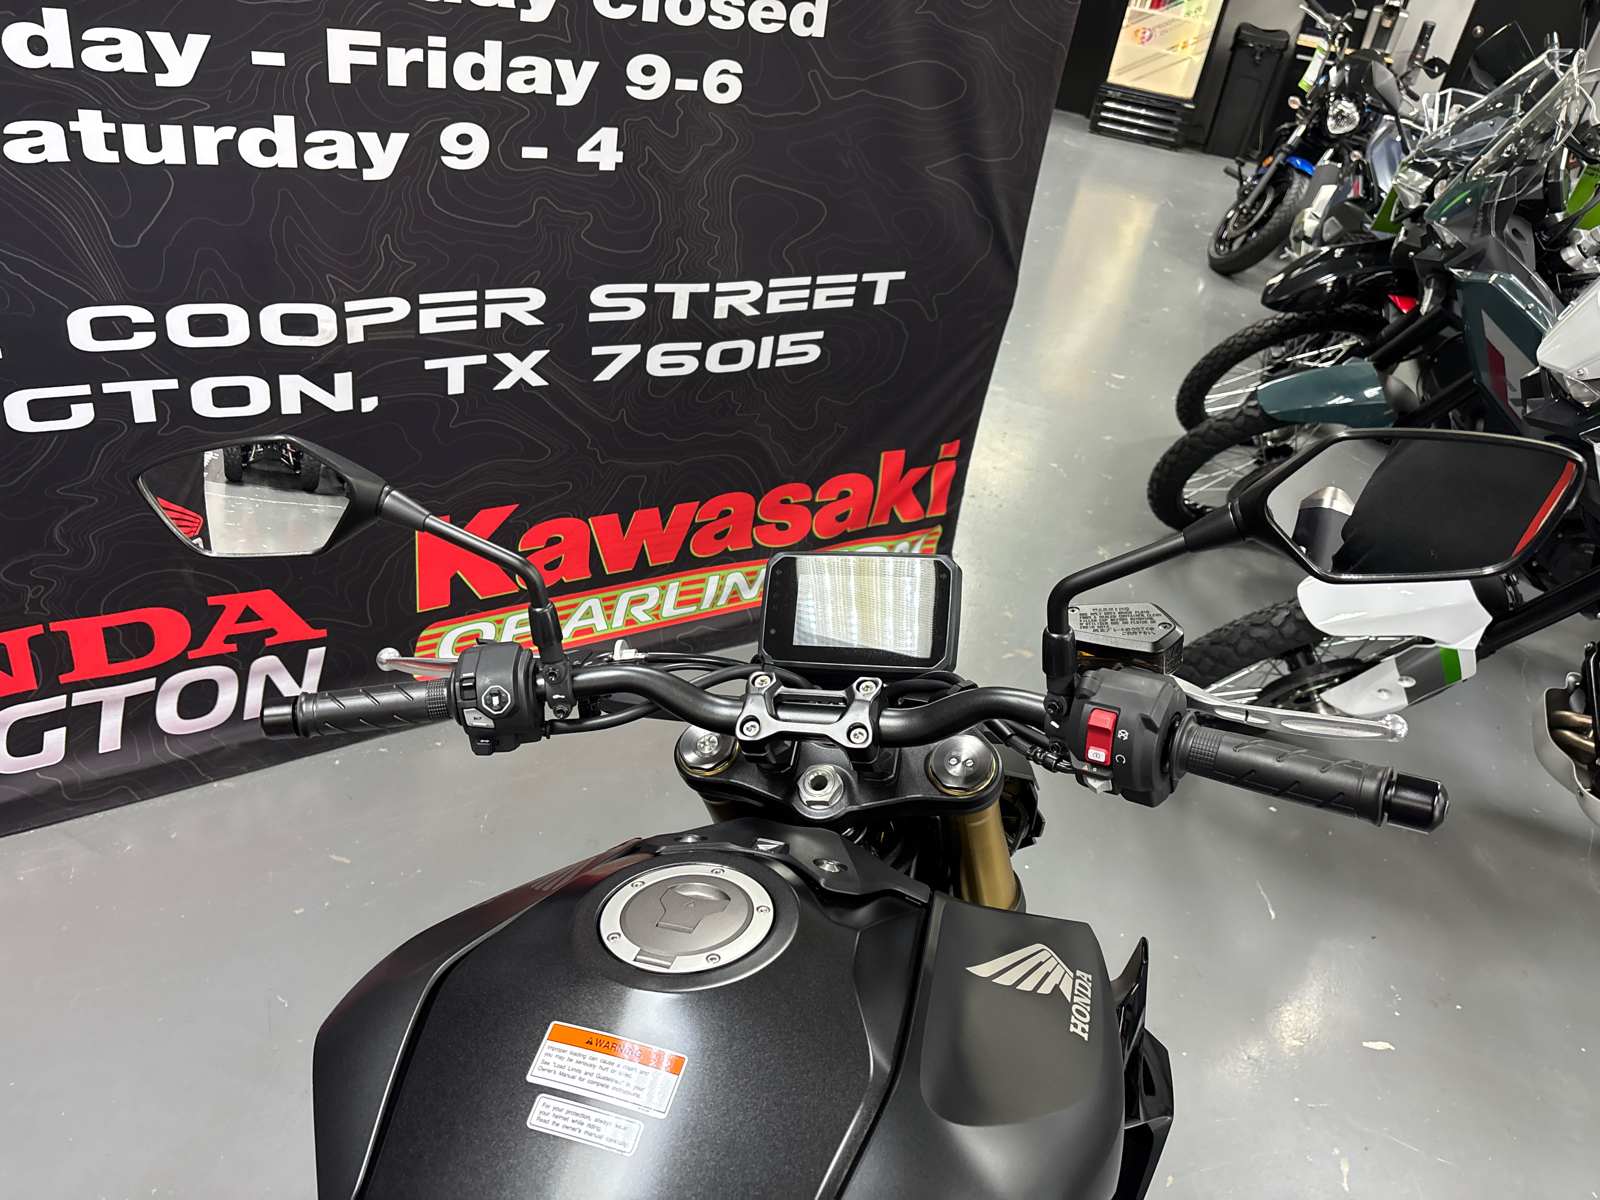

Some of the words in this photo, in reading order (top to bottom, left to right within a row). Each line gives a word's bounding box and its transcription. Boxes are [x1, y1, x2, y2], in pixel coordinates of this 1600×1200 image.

[2, 8, 211, 87] day
[251, 51, 285, 66] -
[327, 28, 599, 106] Friday
[626, 54, 743, 103] 9-6
[3, 109, 409, 180] aturday
[440, 122, 489, 169] 9
[522, 147, 548, 158] -
[577, 127, 623, 170] 4
[67, 288, 545, 352] COOPER
[589, 271, 906, 322] STREET
[4, 372, 378, 432] GTON,
[425, 350, 549, 395] TX
[592, 331, 824, 381] 76015
[417, 440, 959, 611] Kawasaki
[0, 647, 327, 775] GTON
[1069, 969, 1092, 1042] HONDA
[568, 1050, 586, 1059] loading
[574, 1059, 596, 1069] seriously
[594, 1038, 642, 1057] WARNING
[537, 1065, 556, 1074] Owner's
[558, 1071, 576, 1079] Manual
[586, 1078, 609, 1089] complete
[551, 1113, 569, 1121] helmet
[561, 1123, 582, 1132] owner's
[583, 1130, 603, 1139] manual
[565, 1109, 592, 1121] protection,
